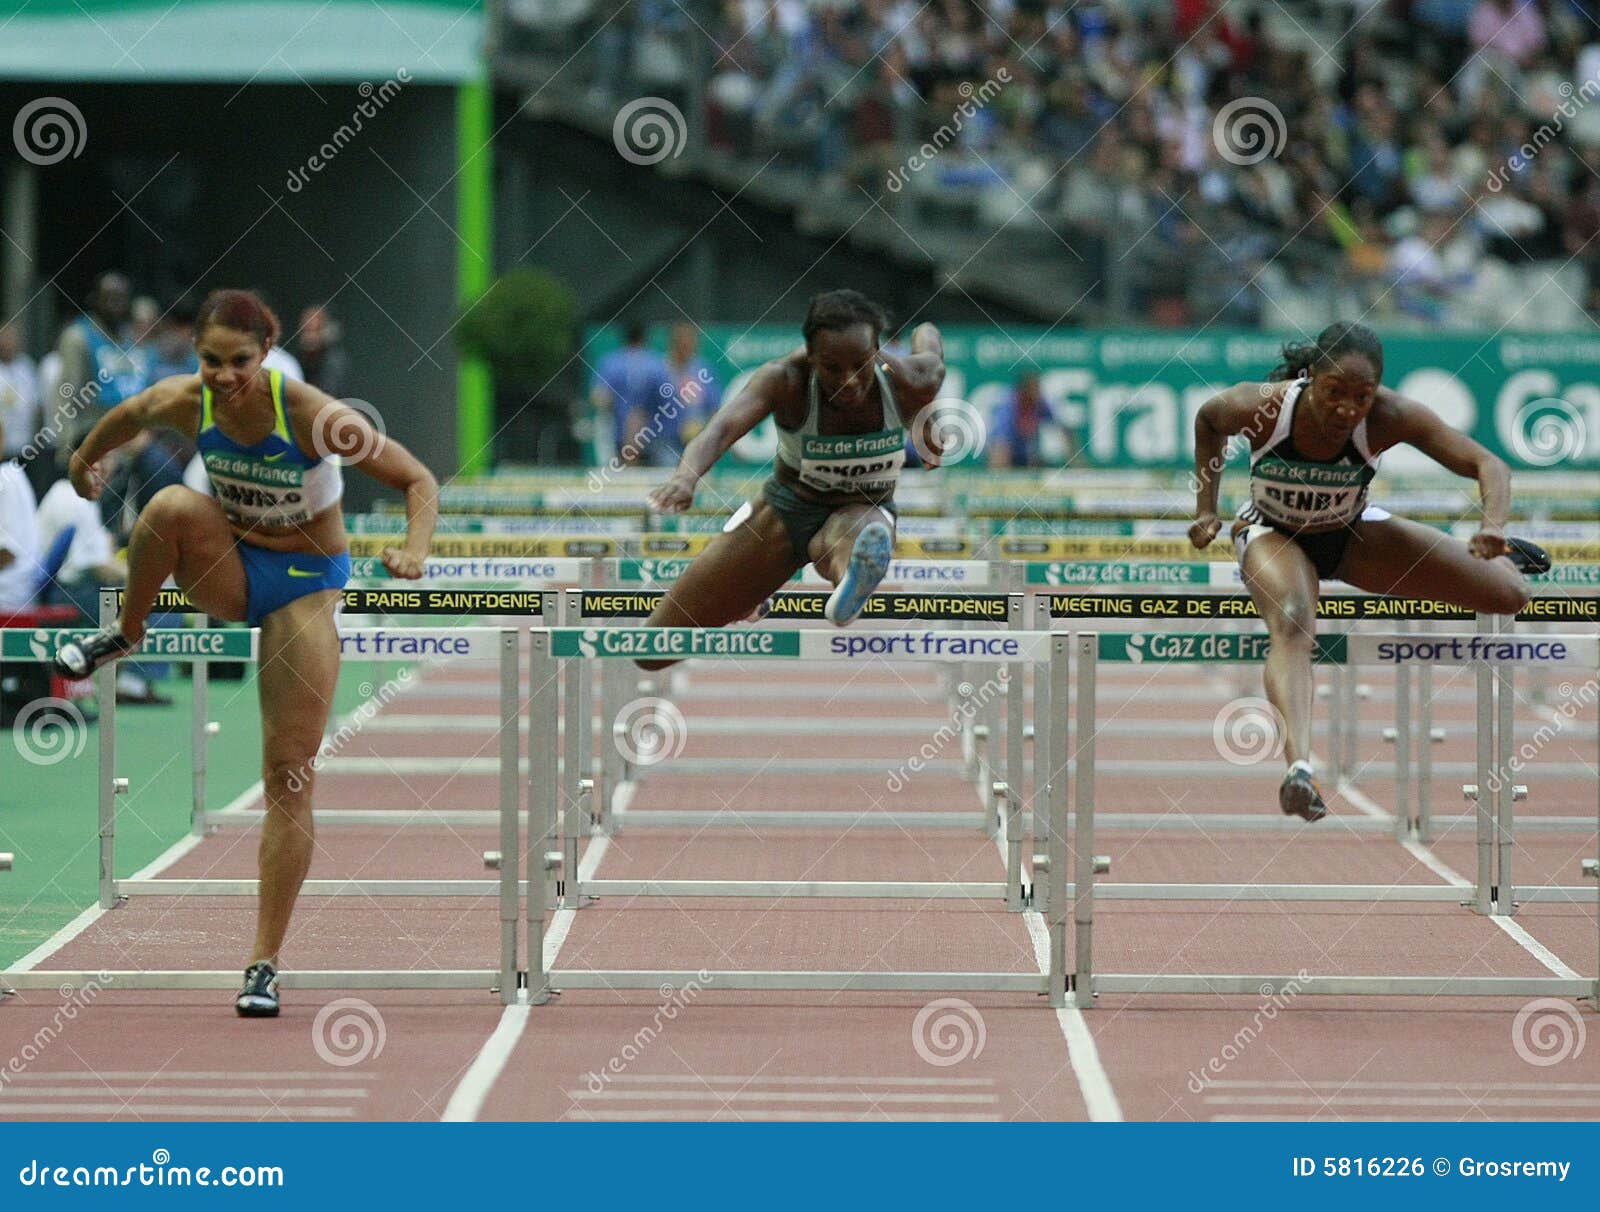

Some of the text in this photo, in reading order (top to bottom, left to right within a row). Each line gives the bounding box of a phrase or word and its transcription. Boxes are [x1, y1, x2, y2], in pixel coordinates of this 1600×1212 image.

[806, 434, 899, 454] Gaz de France
[206, 455, 298, 484] Gaz de France
[1260, 462, 1286, 478] Gaz
[1310, 468, 1358, 482] France
[484, 558, 555, 577] france
[1063, 561, 1192, 583] Gaz de France
[366, 592, 421, 607] PARIS
[428, 593, 541, 608] SAINT-DENIS
[893, 598, 1006, 615] SAINT-DENIS
[1052, 597, 1133, 613] MEETING
[1140, 599, 1179, 614] GAZ
[1186, 600, 1211, 615] DE
[142, 632, 225, 653] France
[372, 631, 470, 654] france
[602, 628, 773, 653] Gaz de France
[831, 631, 1019, 657] sport france
[1149, 632, 1195, 658] Gaz
[1200, 633, 1232, 658] de
[1377, 636, 1567, 663] sport france
